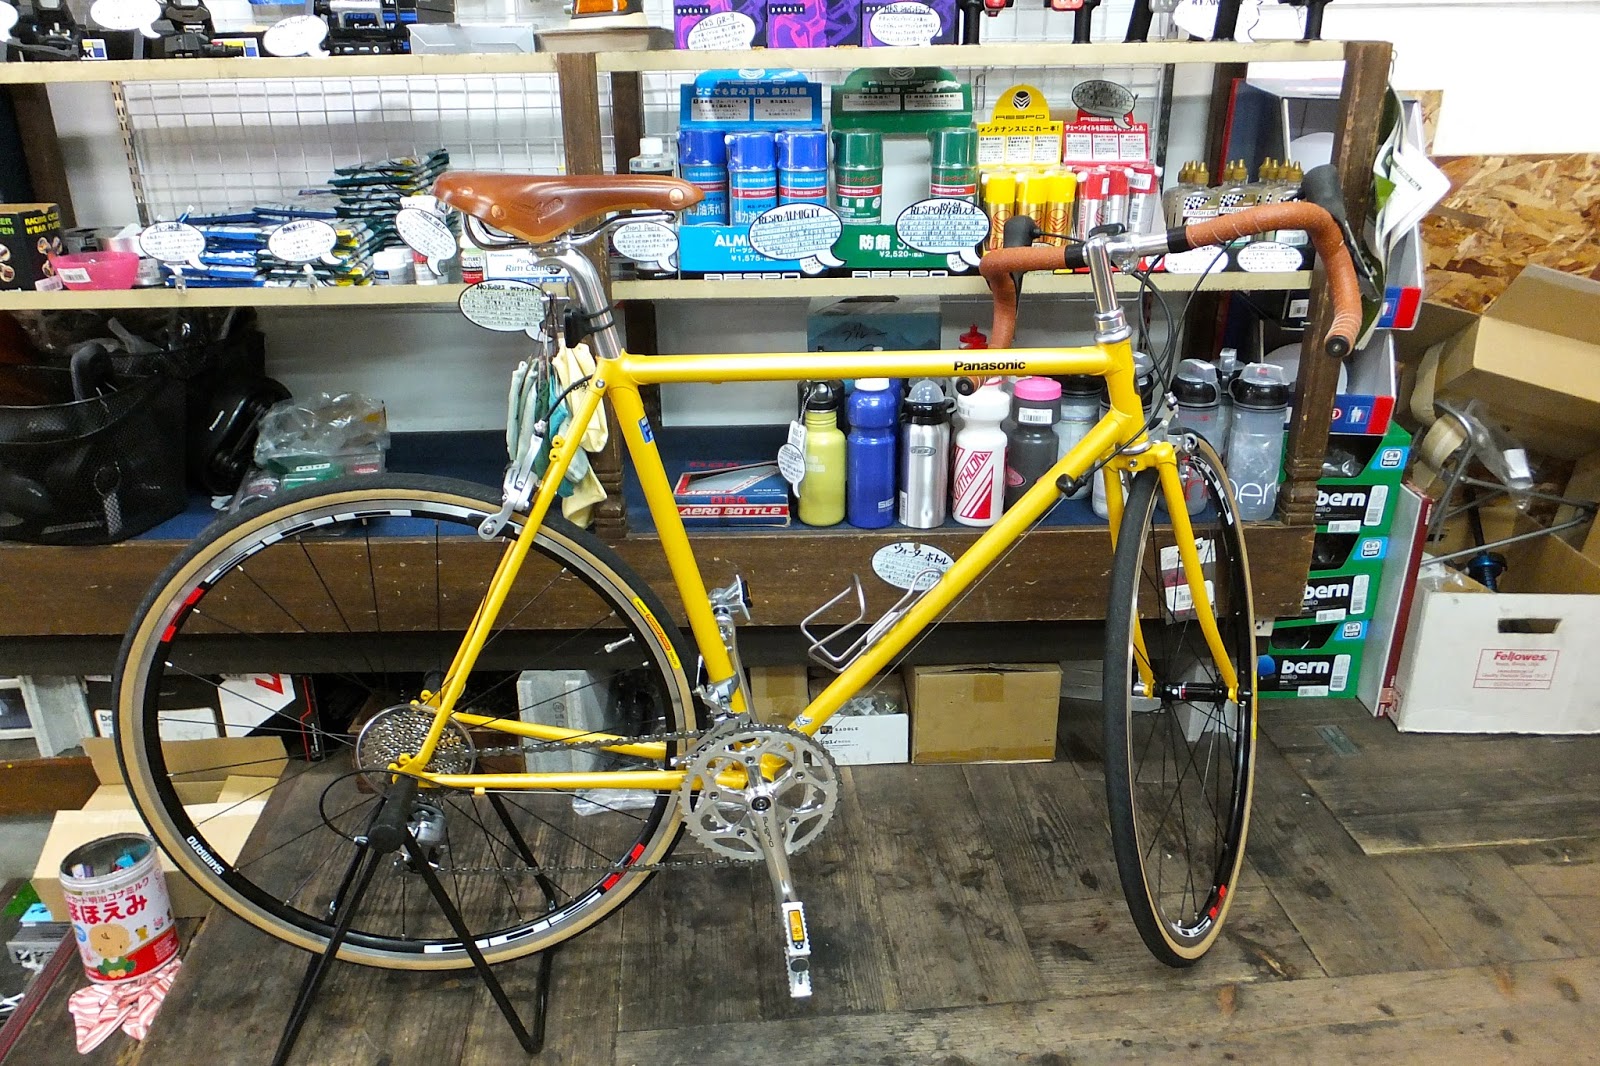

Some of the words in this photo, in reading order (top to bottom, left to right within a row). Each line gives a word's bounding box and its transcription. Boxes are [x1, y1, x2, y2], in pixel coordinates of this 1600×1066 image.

[953, 360, 1026, 371] Panasonic
[1316, 490, 1366, 507] bern
[1303, 583, 1350, 600] bern
[1281, 660, 1330, 674] bern
[186, 835, 225, 875] SHIMANO
